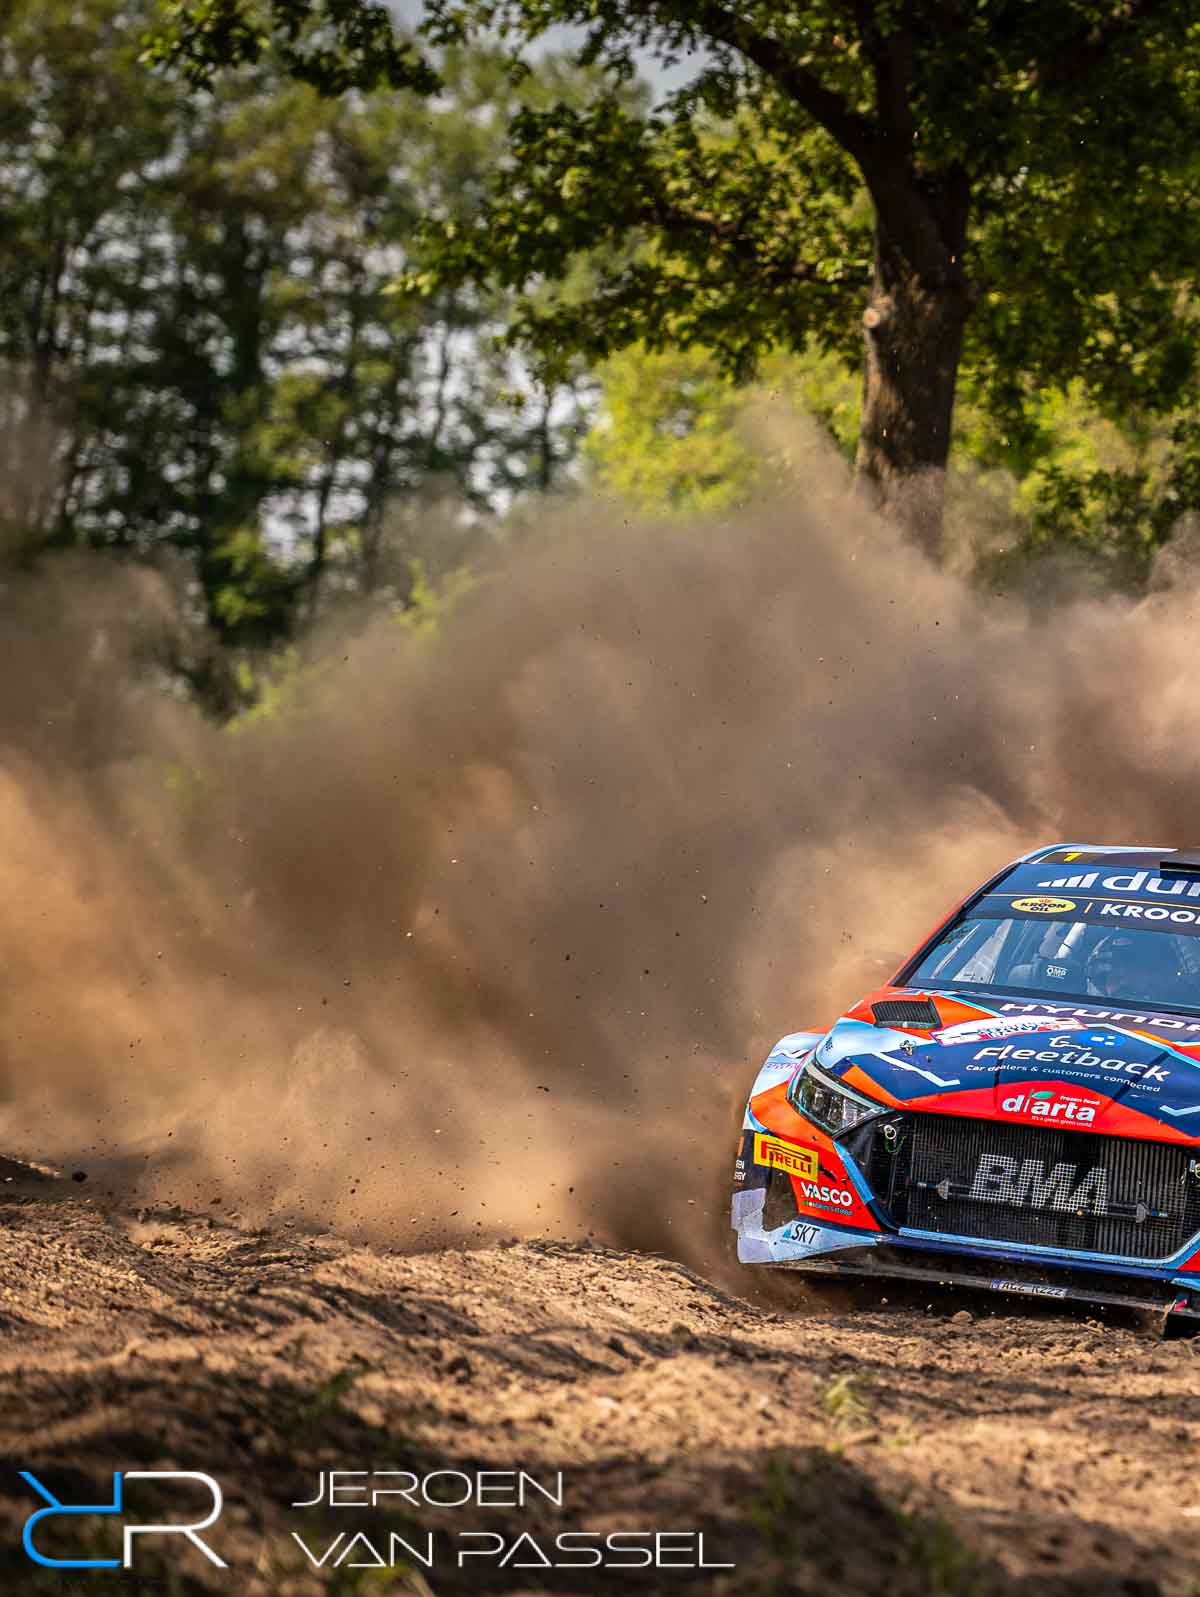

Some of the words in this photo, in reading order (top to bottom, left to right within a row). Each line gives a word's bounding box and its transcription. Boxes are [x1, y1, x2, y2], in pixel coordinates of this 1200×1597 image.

[1019, 901, 1067, 910] KROON
[965, 1063, 987, 1072] Car
[987, 1063, 1027, 1073] dealers
[1042, 1067, 1101, 1080] customers
[1103, 1075, 1161, 1093] connected
[972, 1044, 1171, 1082] Fleetback
[760, 1140, 813, 1175] PIRELLI
[801, 1181, 853, 1207] VASCO
[968, 1152, 1108, 1216] BMA
[791, 1223, 821, 1245] SKT
